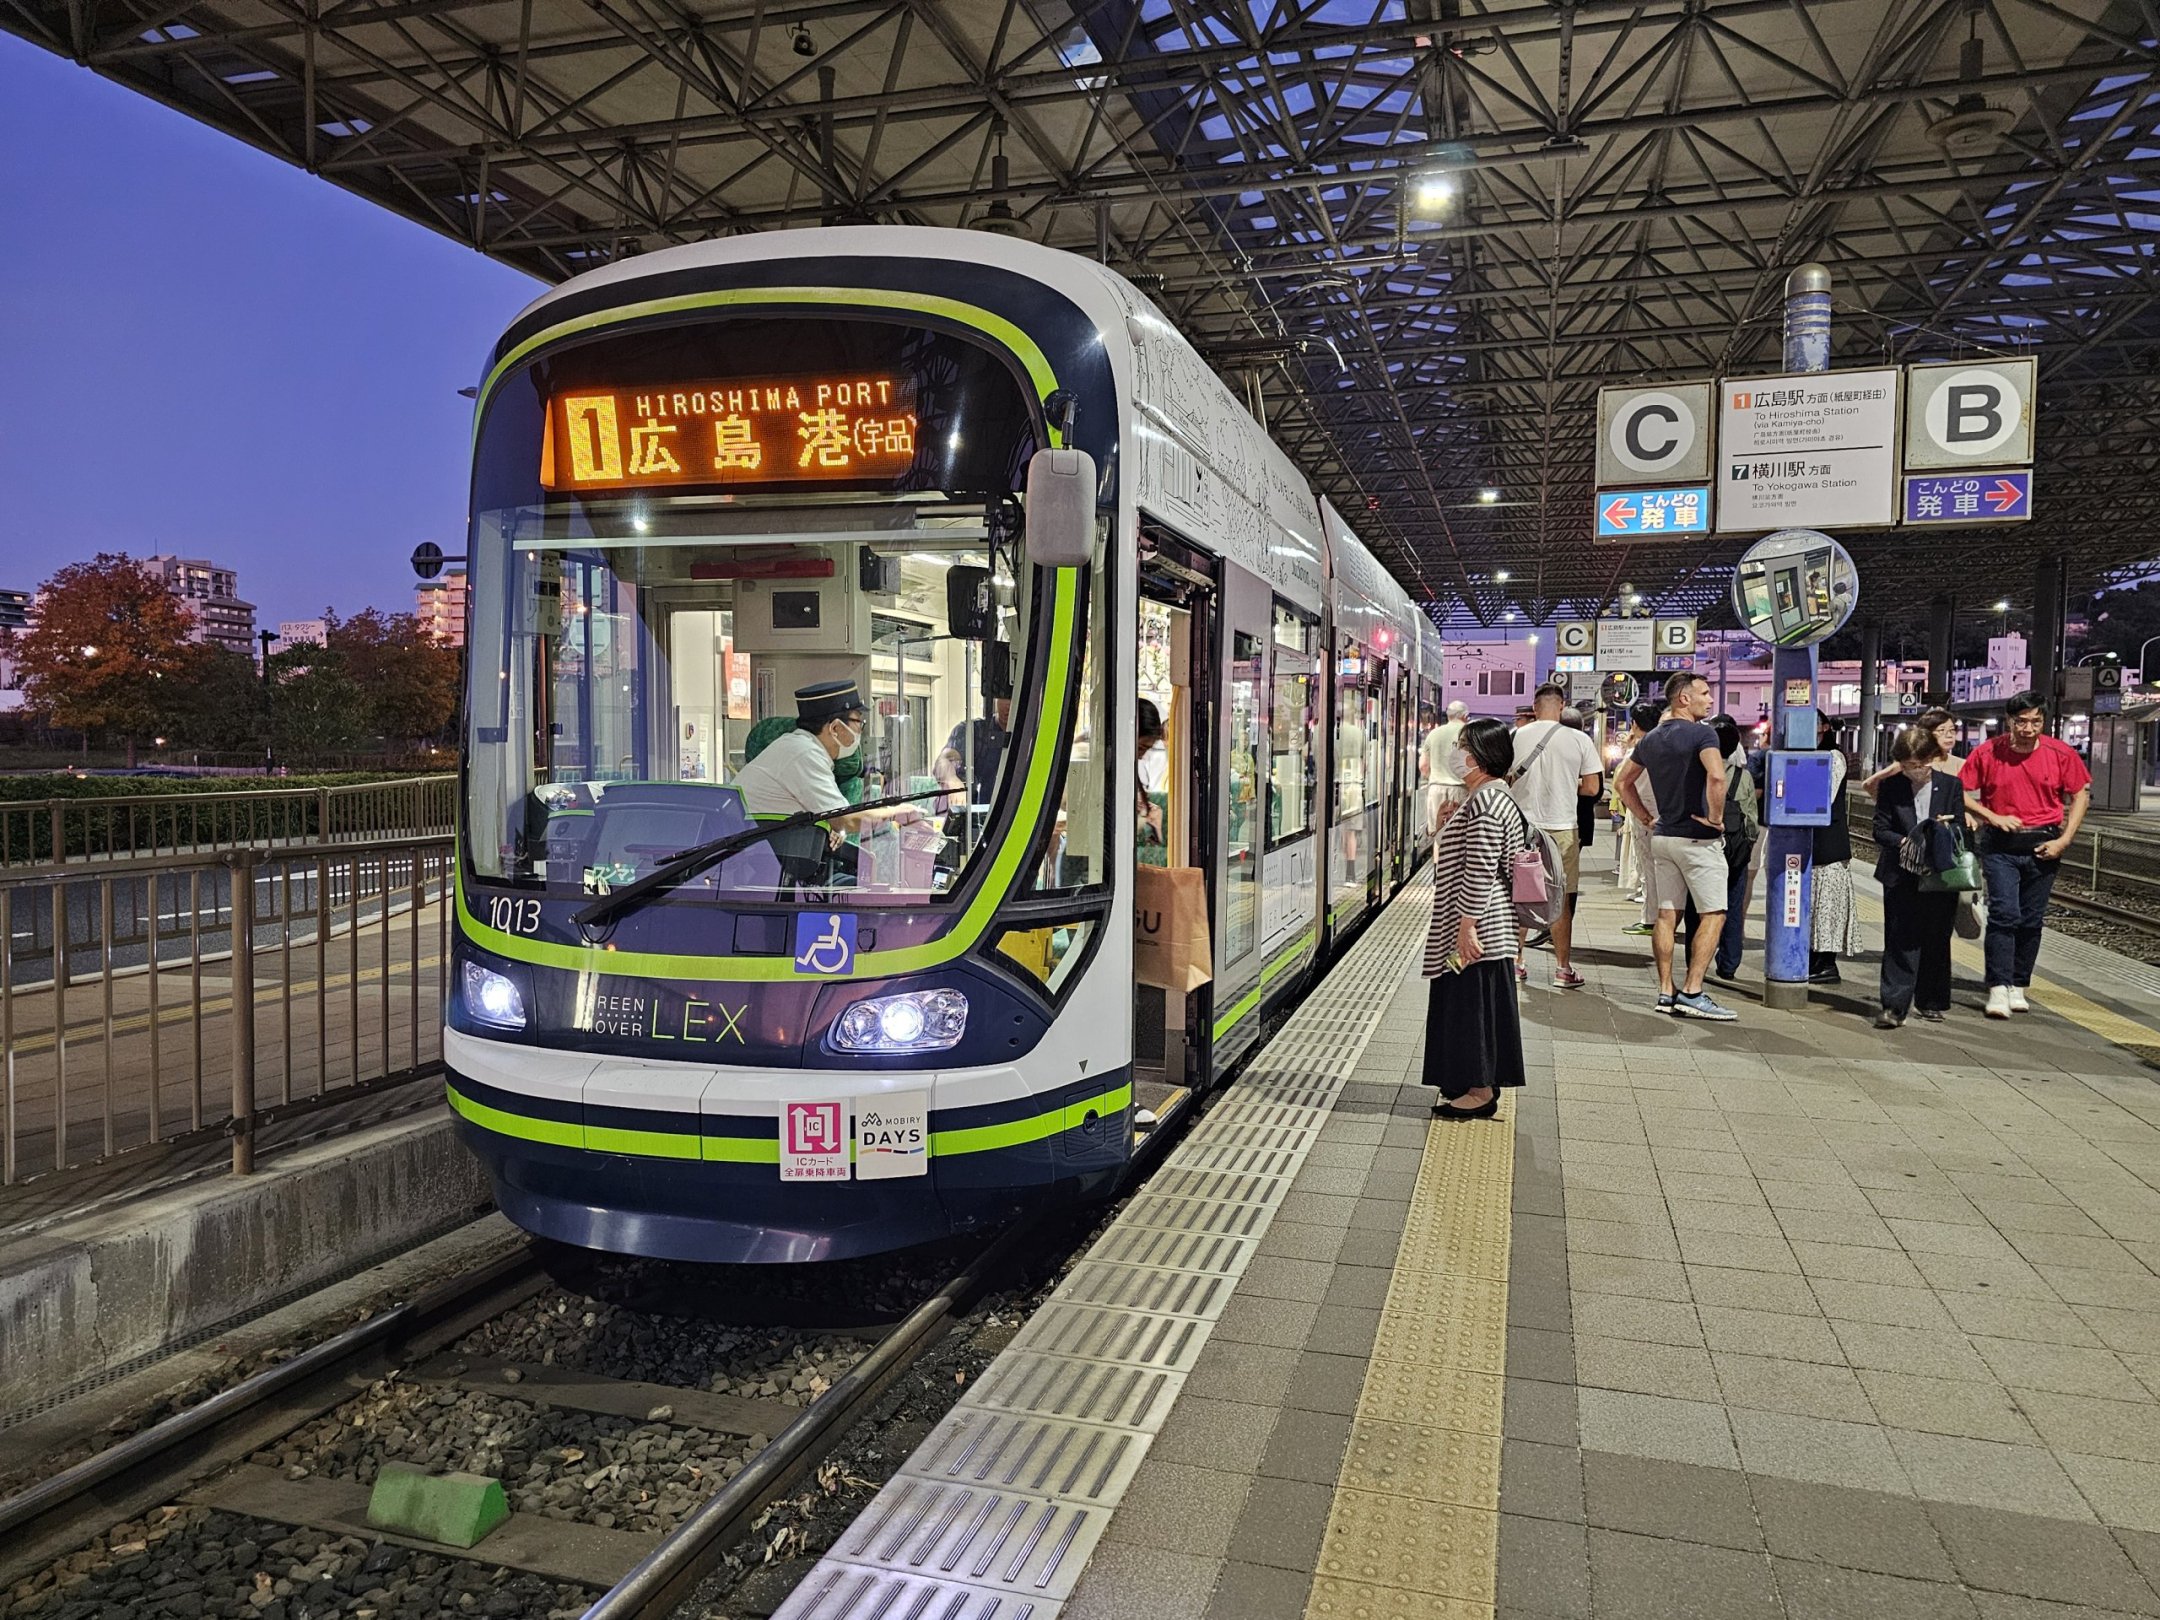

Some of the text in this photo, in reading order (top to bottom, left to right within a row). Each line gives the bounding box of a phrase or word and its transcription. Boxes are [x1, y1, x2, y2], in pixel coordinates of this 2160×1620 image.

[637, 380, 891, 417] HIROSHIMA PORT
[1738, 394, 1746, 409] 1
[1755, 406, 1859, 421] To Hiroshima Station
[1945, 384, 2002, 443] B
[1754, 418, 1825, 429] (via Kamiya-cho)
[1625, 404, 1679, 461] C
[1734, 466, 1747, 479] 7
[1752, 478, 1857, 493] To Yokogawa Station
[1917, 480, 1980, 495] こんどの
[1641, 493, 1699, 508] こんどの
[1916, 493, 1979, 518] 発車
[1640, 508, 1699, 529] 発車
[1565, 627, 1583, 646] C
[1669, 626, 1687, 645] B
[1553, 673, 1564, 685] C
[2102, 670, 2115, 683] A
[1904, 695, 1913, 704] A
[488, 895, 542, 934] 1013
[586, 995, 645, 1012] REEN
[651, 999, 748, 1045] LEX
[808, 1121, 820, 1131] IC
[885, 1116, 921, 1126] MOBIRY
[863, 1129, 920, 1146] DAYS
[796, 1157, 834, 1167] ICカード
